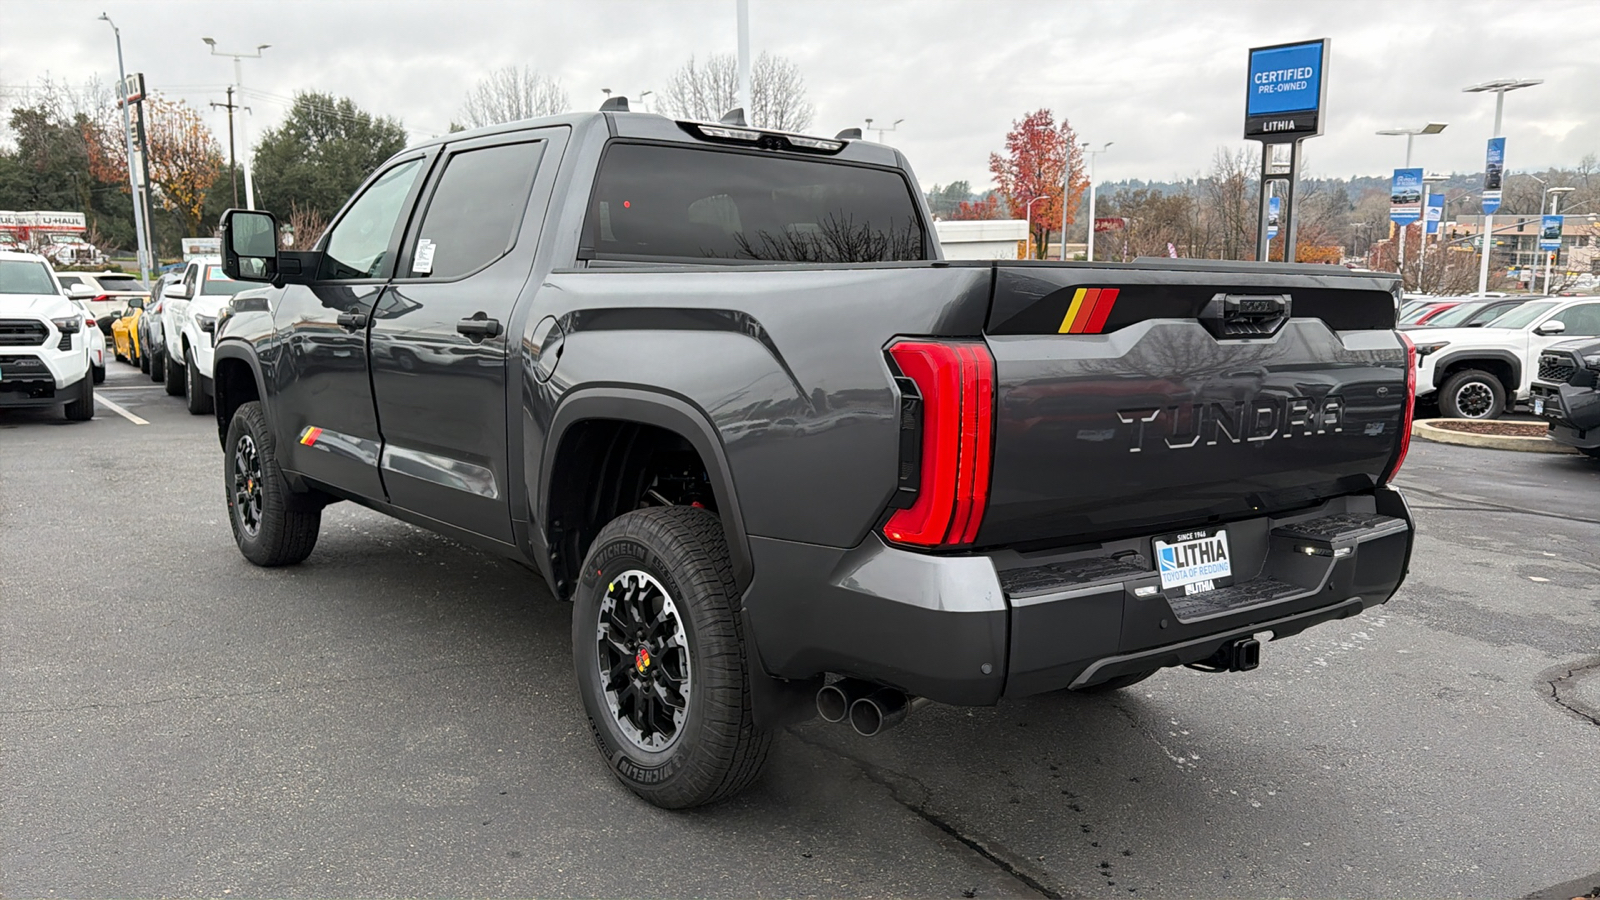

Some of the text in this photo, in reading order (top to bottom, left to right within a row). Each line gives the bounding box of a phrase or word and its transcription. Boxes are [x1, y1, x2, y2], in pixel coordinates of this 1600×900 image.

[1254, 67, 1313, 84] CERTIFIED
[1258, 81, 1308, 94] PRE-OWNED
[1263, 119, 1295, 132] LITHIA
[43, 217, 81, 225] U-HAUL
[1117, 394, 1347, 453] TUNDRA
[1177, 533, 1193, 541] SINCE
[594, 542, 645, 567] MICHELIN
[1174, 539, 1227, 569] LITHIA
[1162, 563, 1228, 582] TOYOTA OF REDDING
[1191, 580, 1215, 594] LITHIA
[618, 760, 674, 784] MICHELIN
